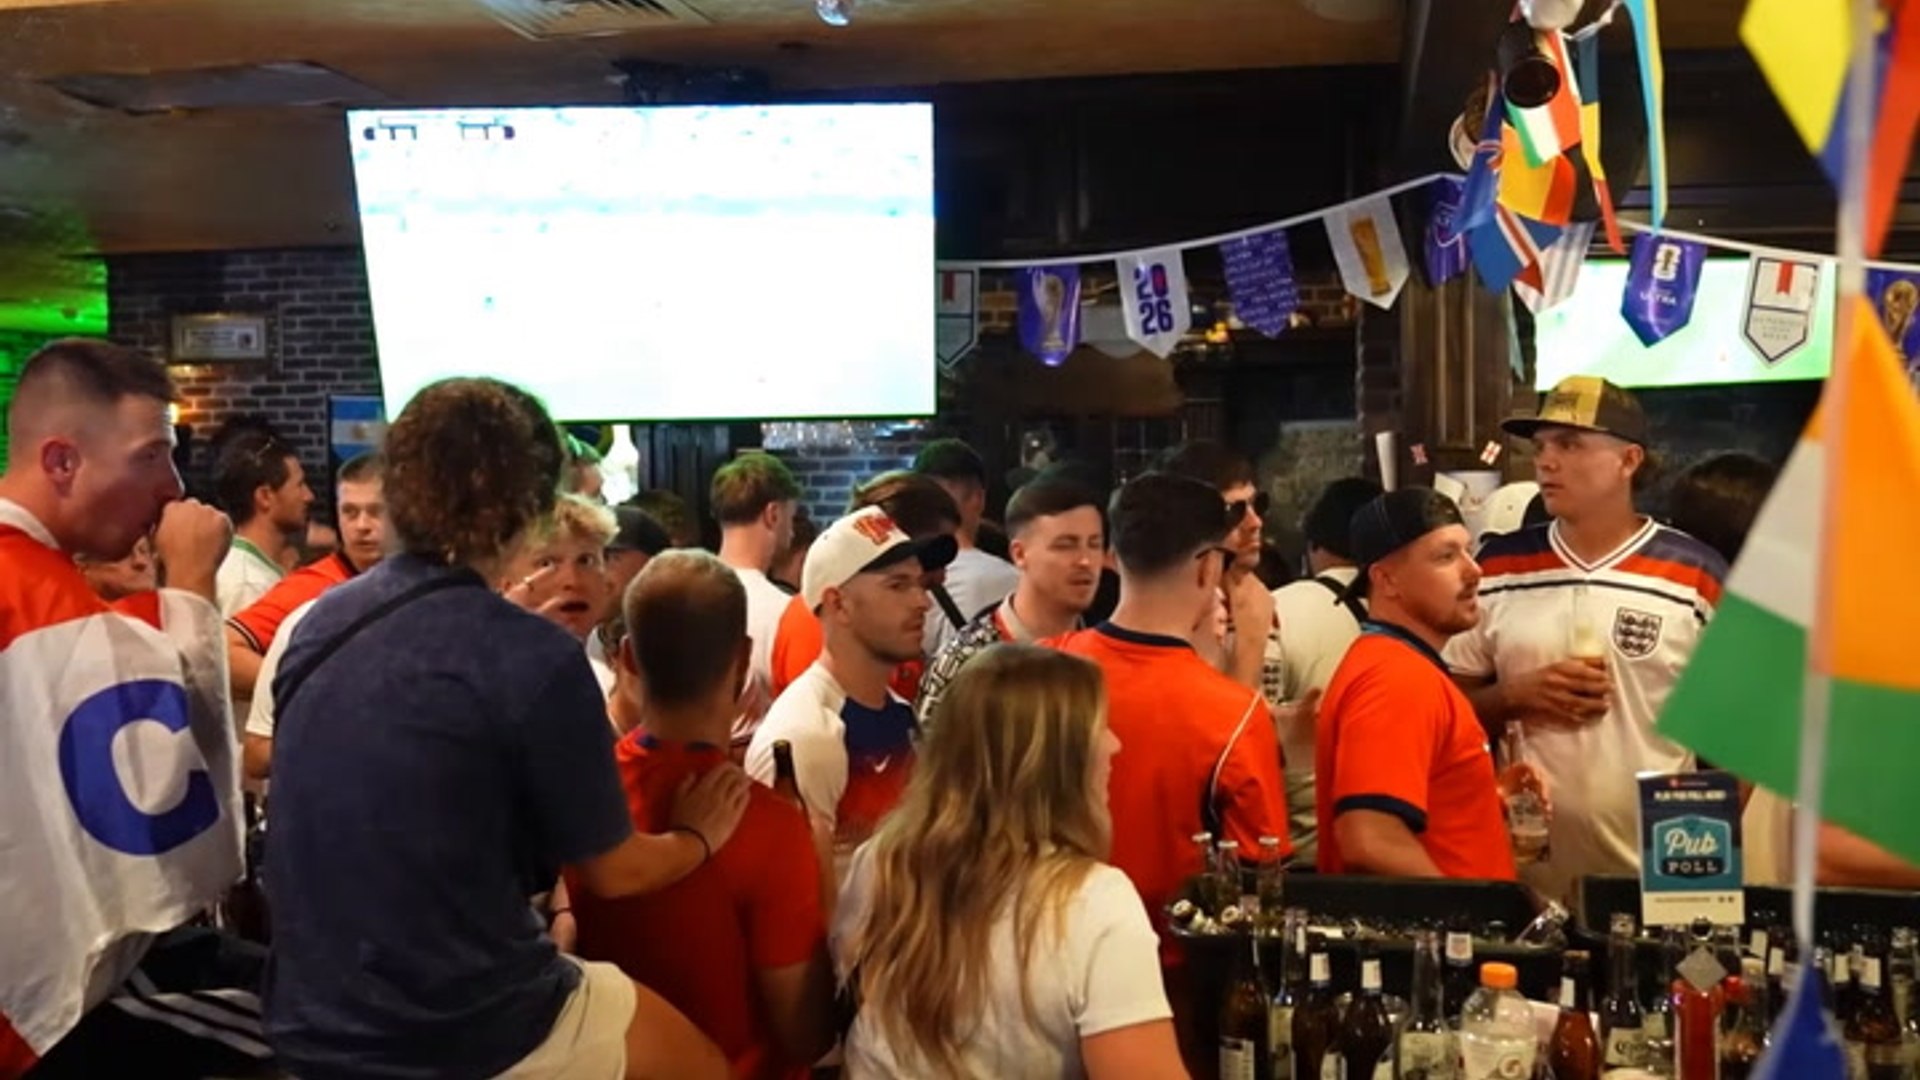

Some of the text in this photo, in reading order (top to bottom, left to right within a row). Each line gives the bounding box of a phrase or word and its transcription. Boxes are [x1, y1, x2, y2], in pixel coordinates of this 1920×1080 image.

[1133, 262, 1168, 300] 20
[1139, 299, 1174, 335] 26
[59, 679, 220, 855] C
[1664, 827, 1717, 857] Pub
[1667, 861, 1717, 873] POLL
